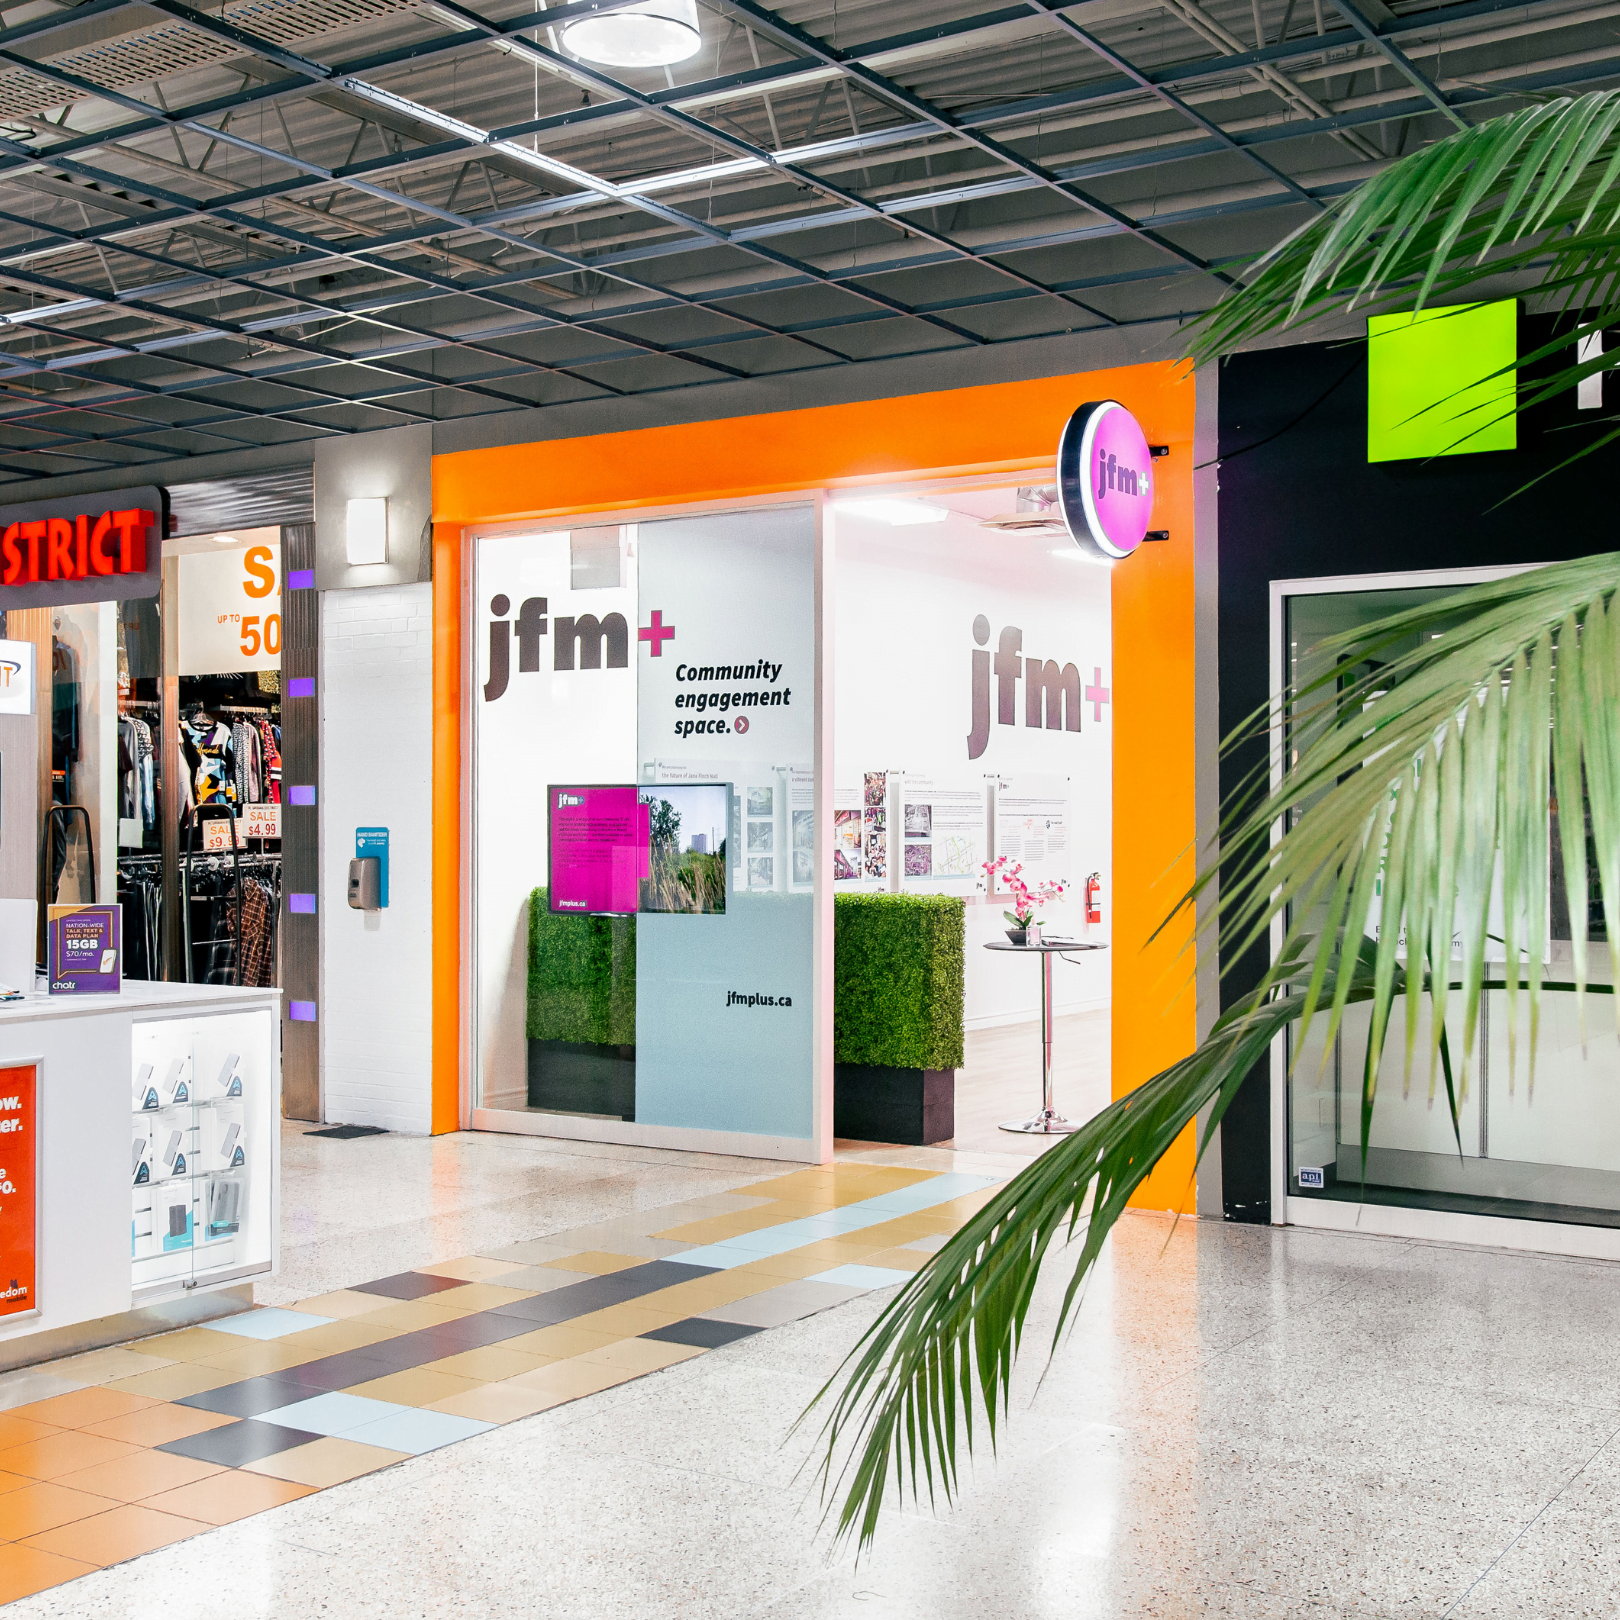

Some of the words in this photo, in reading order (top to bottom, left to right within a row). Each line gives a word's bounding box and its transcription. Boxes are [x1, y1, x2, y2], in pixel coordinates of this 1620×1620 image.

[1098, 448, 1150, 500] jfm+
[242, 545, 281, 599] S
[217, 614, 228, 624] UP
[229, 613, 240, 623] TO
[483, 593, 676, 702] jfm+
[0, 665, 13, 687] T
[675, 658, 783, 683] Community
[966, 613, 1110, 760] jfm+
[674, 687, 791, 712] engagement
[674, 719, 731, 739] space.
[250, 811, 277, 822] SALE
[210, 825, 240, 835] SALE
[248, 823, 276, 836] $4.99
[66, 940, 98, 949] 15GB
[726, 990, 793, 1008] jfmplus.ca
[0, 1117, 23, 1133] er.
